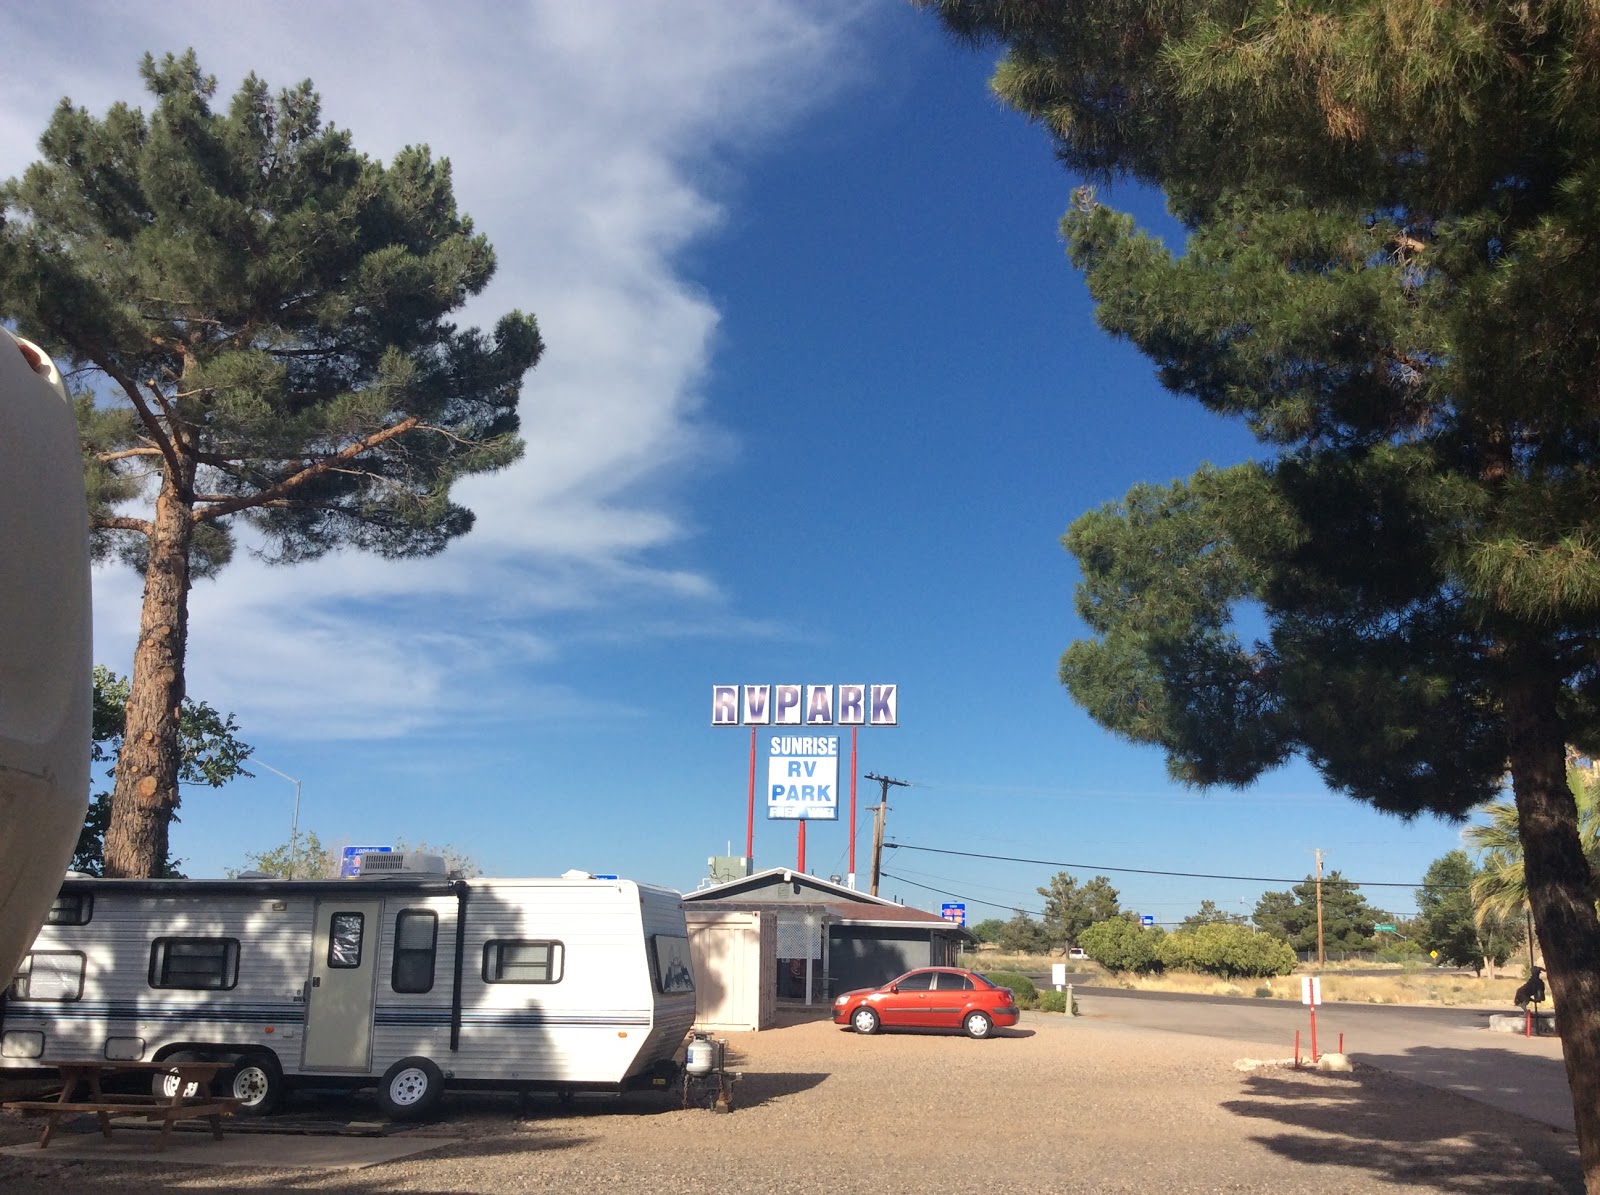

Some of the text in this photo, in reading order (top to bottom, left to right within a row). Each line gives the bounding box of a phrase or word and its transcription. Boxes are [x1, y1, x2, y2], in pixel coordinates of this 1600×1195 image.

[770, 736, 838, 755] SUNRISE
[787, 760, 817, 778] RV
[771, 784, 832, 802] PARK
